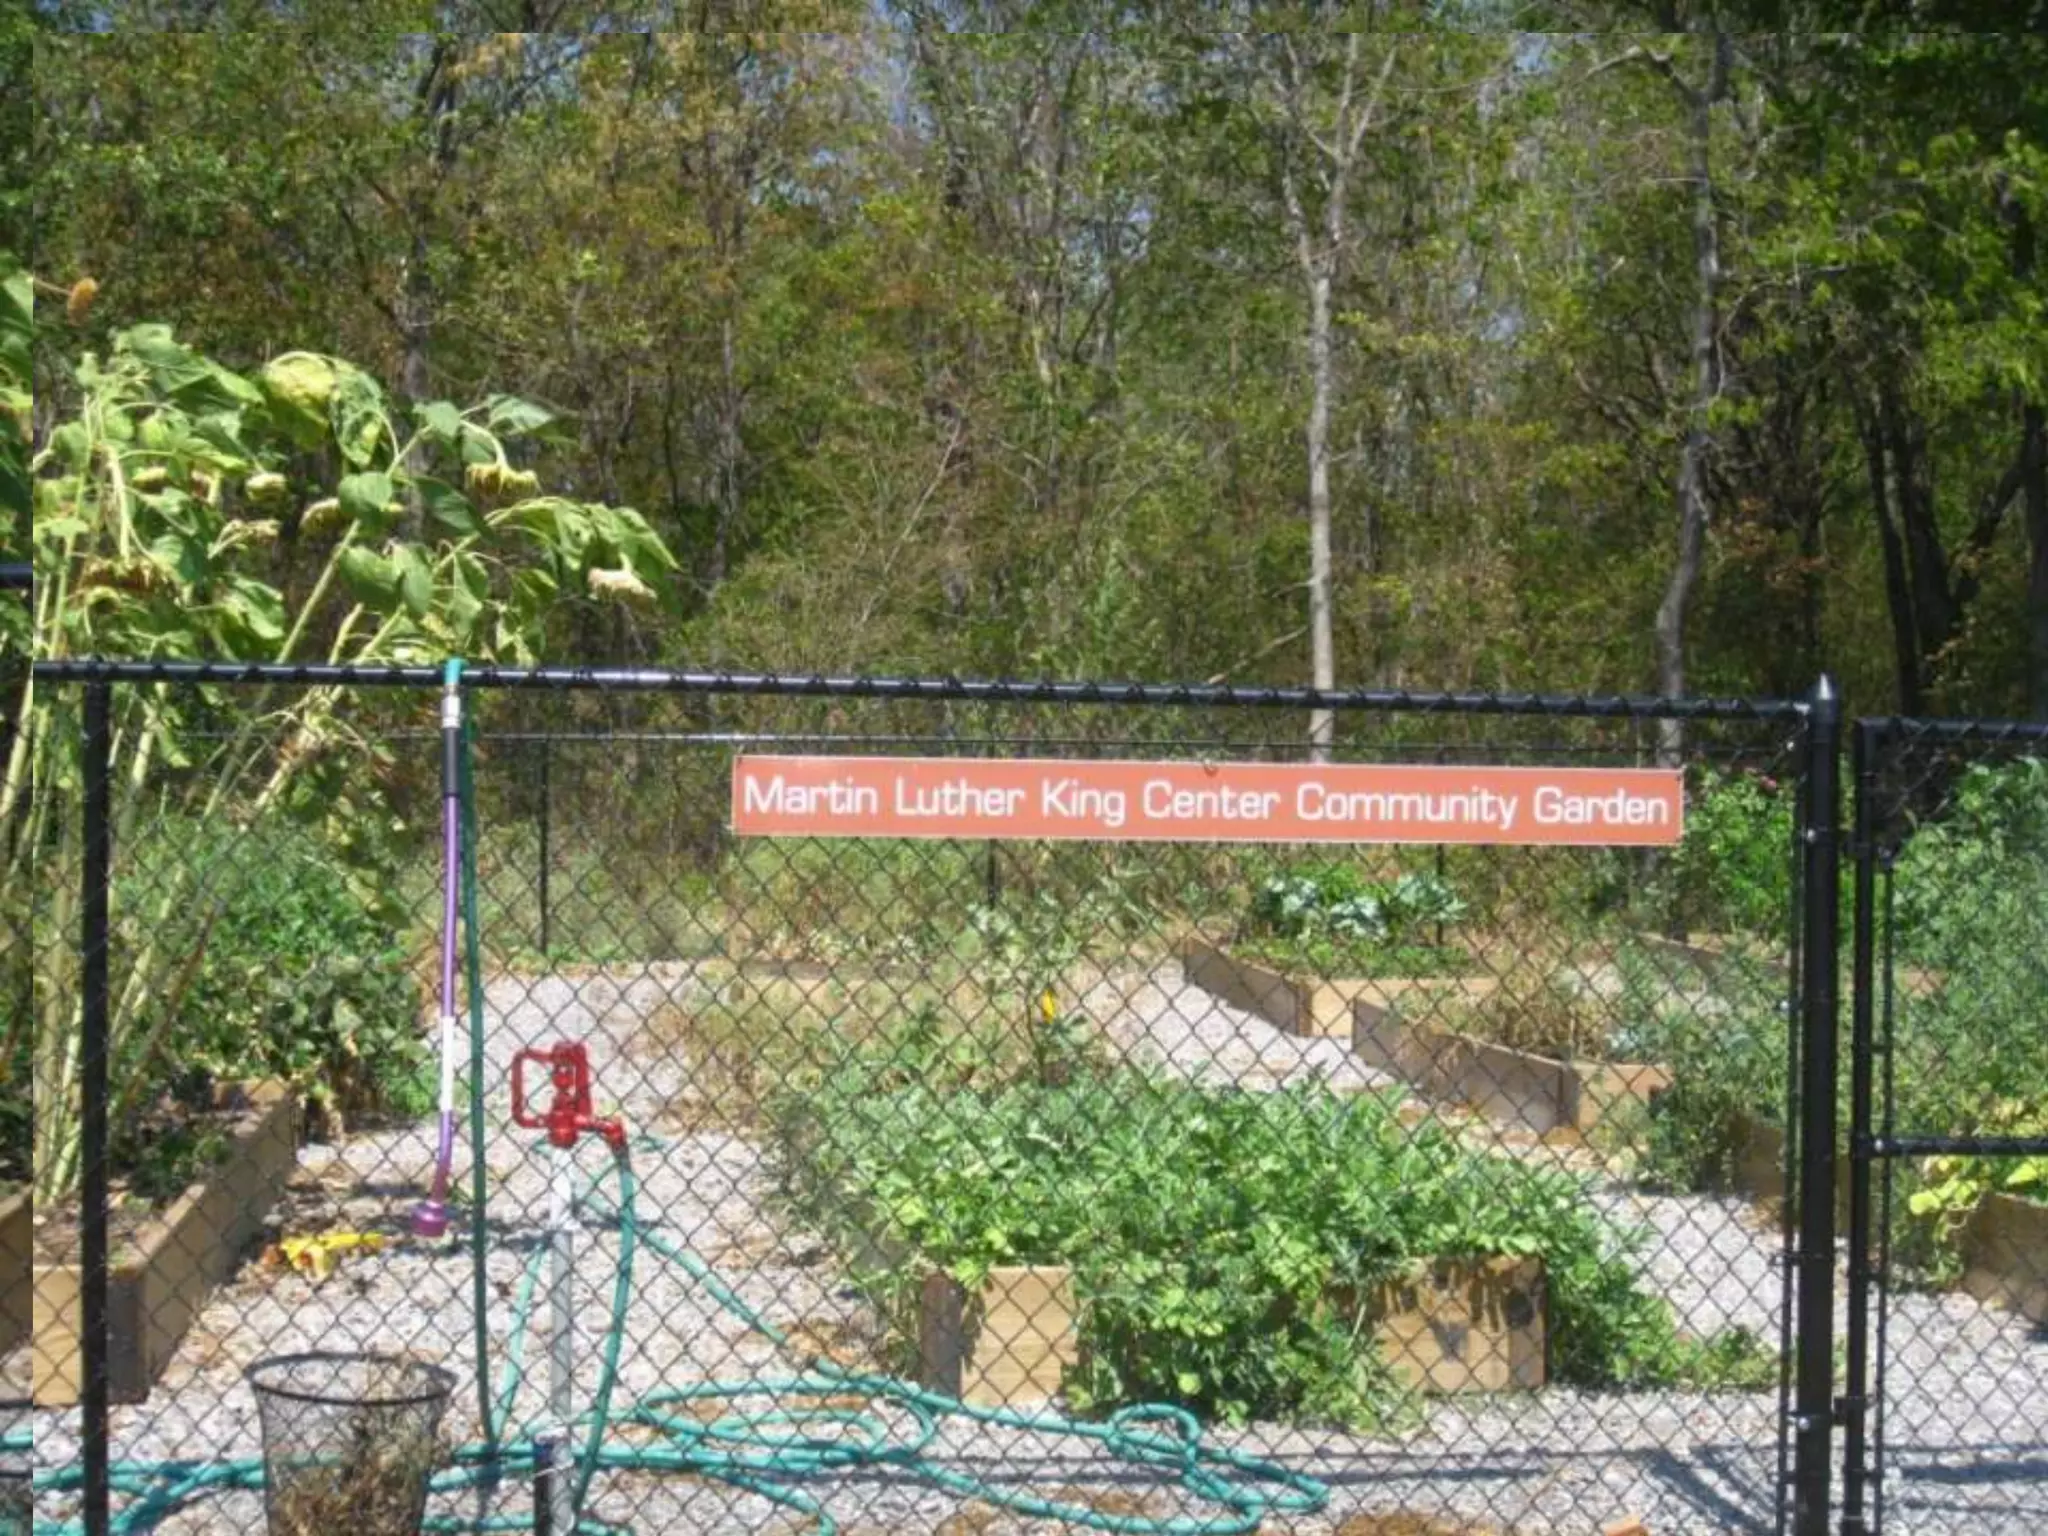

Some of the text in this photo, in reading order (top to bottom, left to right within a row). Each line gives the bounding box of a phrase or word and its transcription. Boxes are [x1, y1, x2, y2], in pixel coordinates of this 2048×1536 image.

[743, 775, 1669, 830] Martin Luther King Center Community Garden
